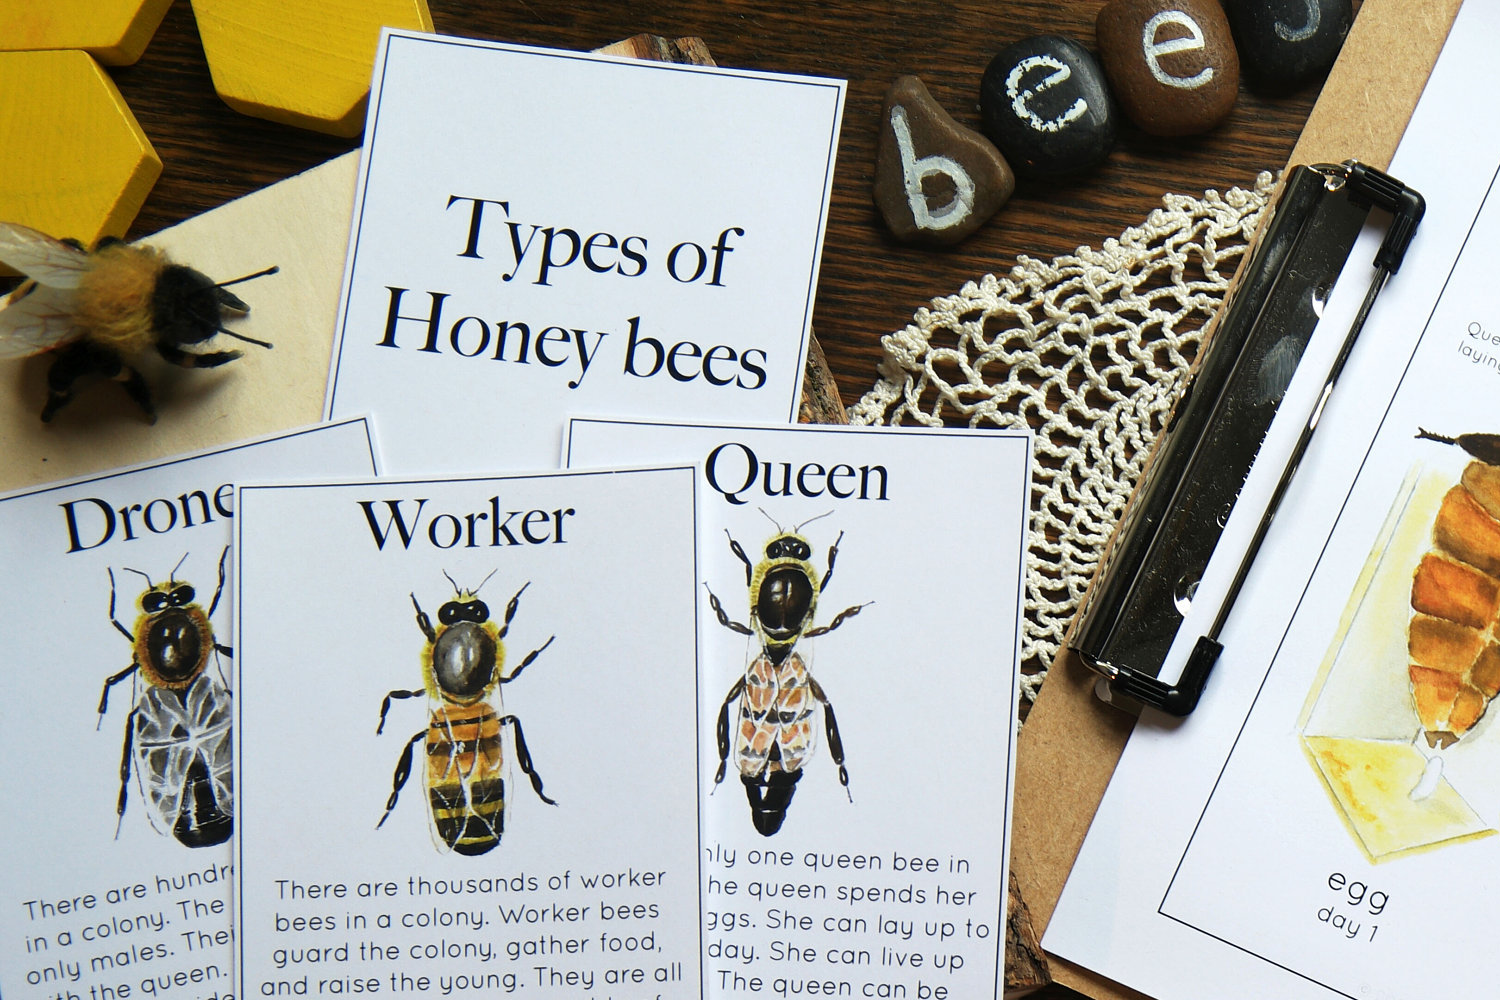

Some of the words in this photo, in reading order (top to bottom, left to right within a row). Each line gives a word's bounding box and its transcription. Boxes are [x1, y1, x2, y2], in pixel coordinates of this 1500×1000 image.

[446, 195, 647, 286] Types
[667, 227, 744, 287] of
[376, 286, 609, 389] Honey
[624, 316, 766, 389] bees
[705, 443, 890, 505] Queen
[58, 482, 234, 555] Drone
[356, 496, 575, 551] Worker
[748, 851, 793, 866] one
[804, 853, 881, 872] queen
[893, 852, 939, 872] bee
[950, 859, 969, 873] in
[275, 880, 347, 899] There
[357, 882, 397, 897] are
[408, 872, 538, 895] thousands
[548, 870, 570, 890] of
[581, 868, 666, 888] worker
[748, 882, 826, 901] queen
[837, 884, 926, 906] spends
[937, 885, 976, 905] her
[1328, 873, 1389, 915] egg
[23, 895, 96, 920] There
[106, 884, 146, 904] are
[276, 913, 335, 931] bees
[347, 912, 366, 929] in
[377, 915, 390, 928] a
[402, 908, 489, 930] colony.
[499, 903, 590, 924] Worker
[601, 901, 659, 920] bees
[27, 937, 47, 952] in
[58, 932, 72, 946] a
[82, 912, 170, 941] colony.
[176, 899, 224, 920] The
[766, 909, 813, 930] She
[824, 918, 866, 933] can
[879, 915, 913, 940] lay
[925, 922, 954, 942] up
[966, 919, 989, 938] to
[1318, 907, 1360, 938] day
[1370, 926, 1378, 942] 1
[27, 960, 80, 984] only
[91, 944, 174, 972] males.
[273, 942, 348, 968] guard
[360, 941, 399, 960] the
[410, 939, 496, 962] colony,
[507, 935, 589, 961] gather
[600, 931, 661, 952] food,
[709, 939, 759, 964] day.
[770, 941, 816, 962] She
[827, 950, 870, 965] can
[883, 946, 923, 967] live
[934, 954, 964, 974] up
[141, 966, 227, 997] queen.
[261, 976, 307, 996] and
[319, 979, 380, 994] raise
[390, 972, 430, 991] the
[440, 974, 524, 995] young.
[533, 967, 593, 990] They
[605, 969, 644, 984] are
[654, 962, 681, 982] all
